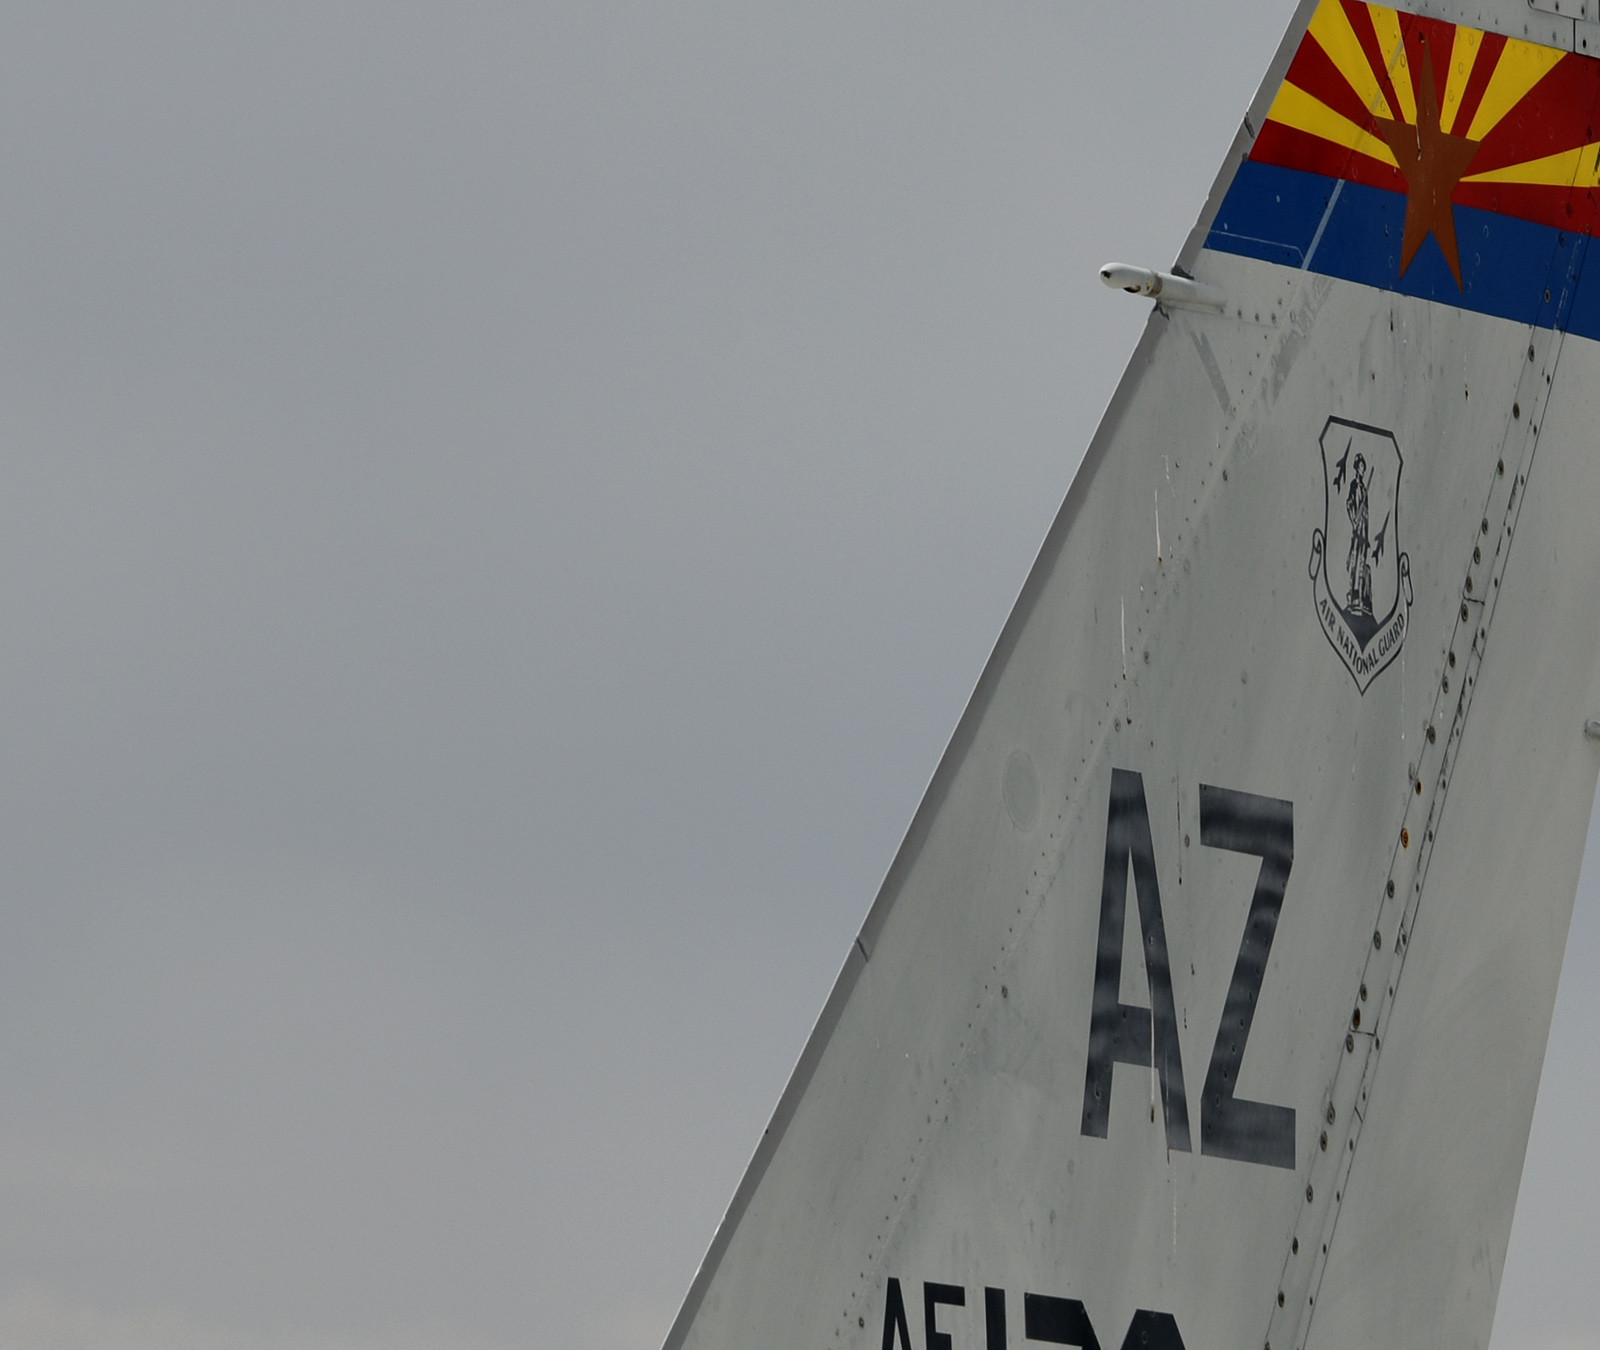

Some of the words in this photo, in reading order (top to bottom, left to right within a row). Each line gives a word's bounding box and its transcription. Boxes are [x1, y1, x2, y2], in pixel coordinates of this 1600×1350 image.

[1320, 599, 1336, 632] AIR
[1337, 625, 1379, 675] NATIONAL
[1379, 613, 1405, 657] GUARD
[1080, 767, 1296, 1170] AZ
